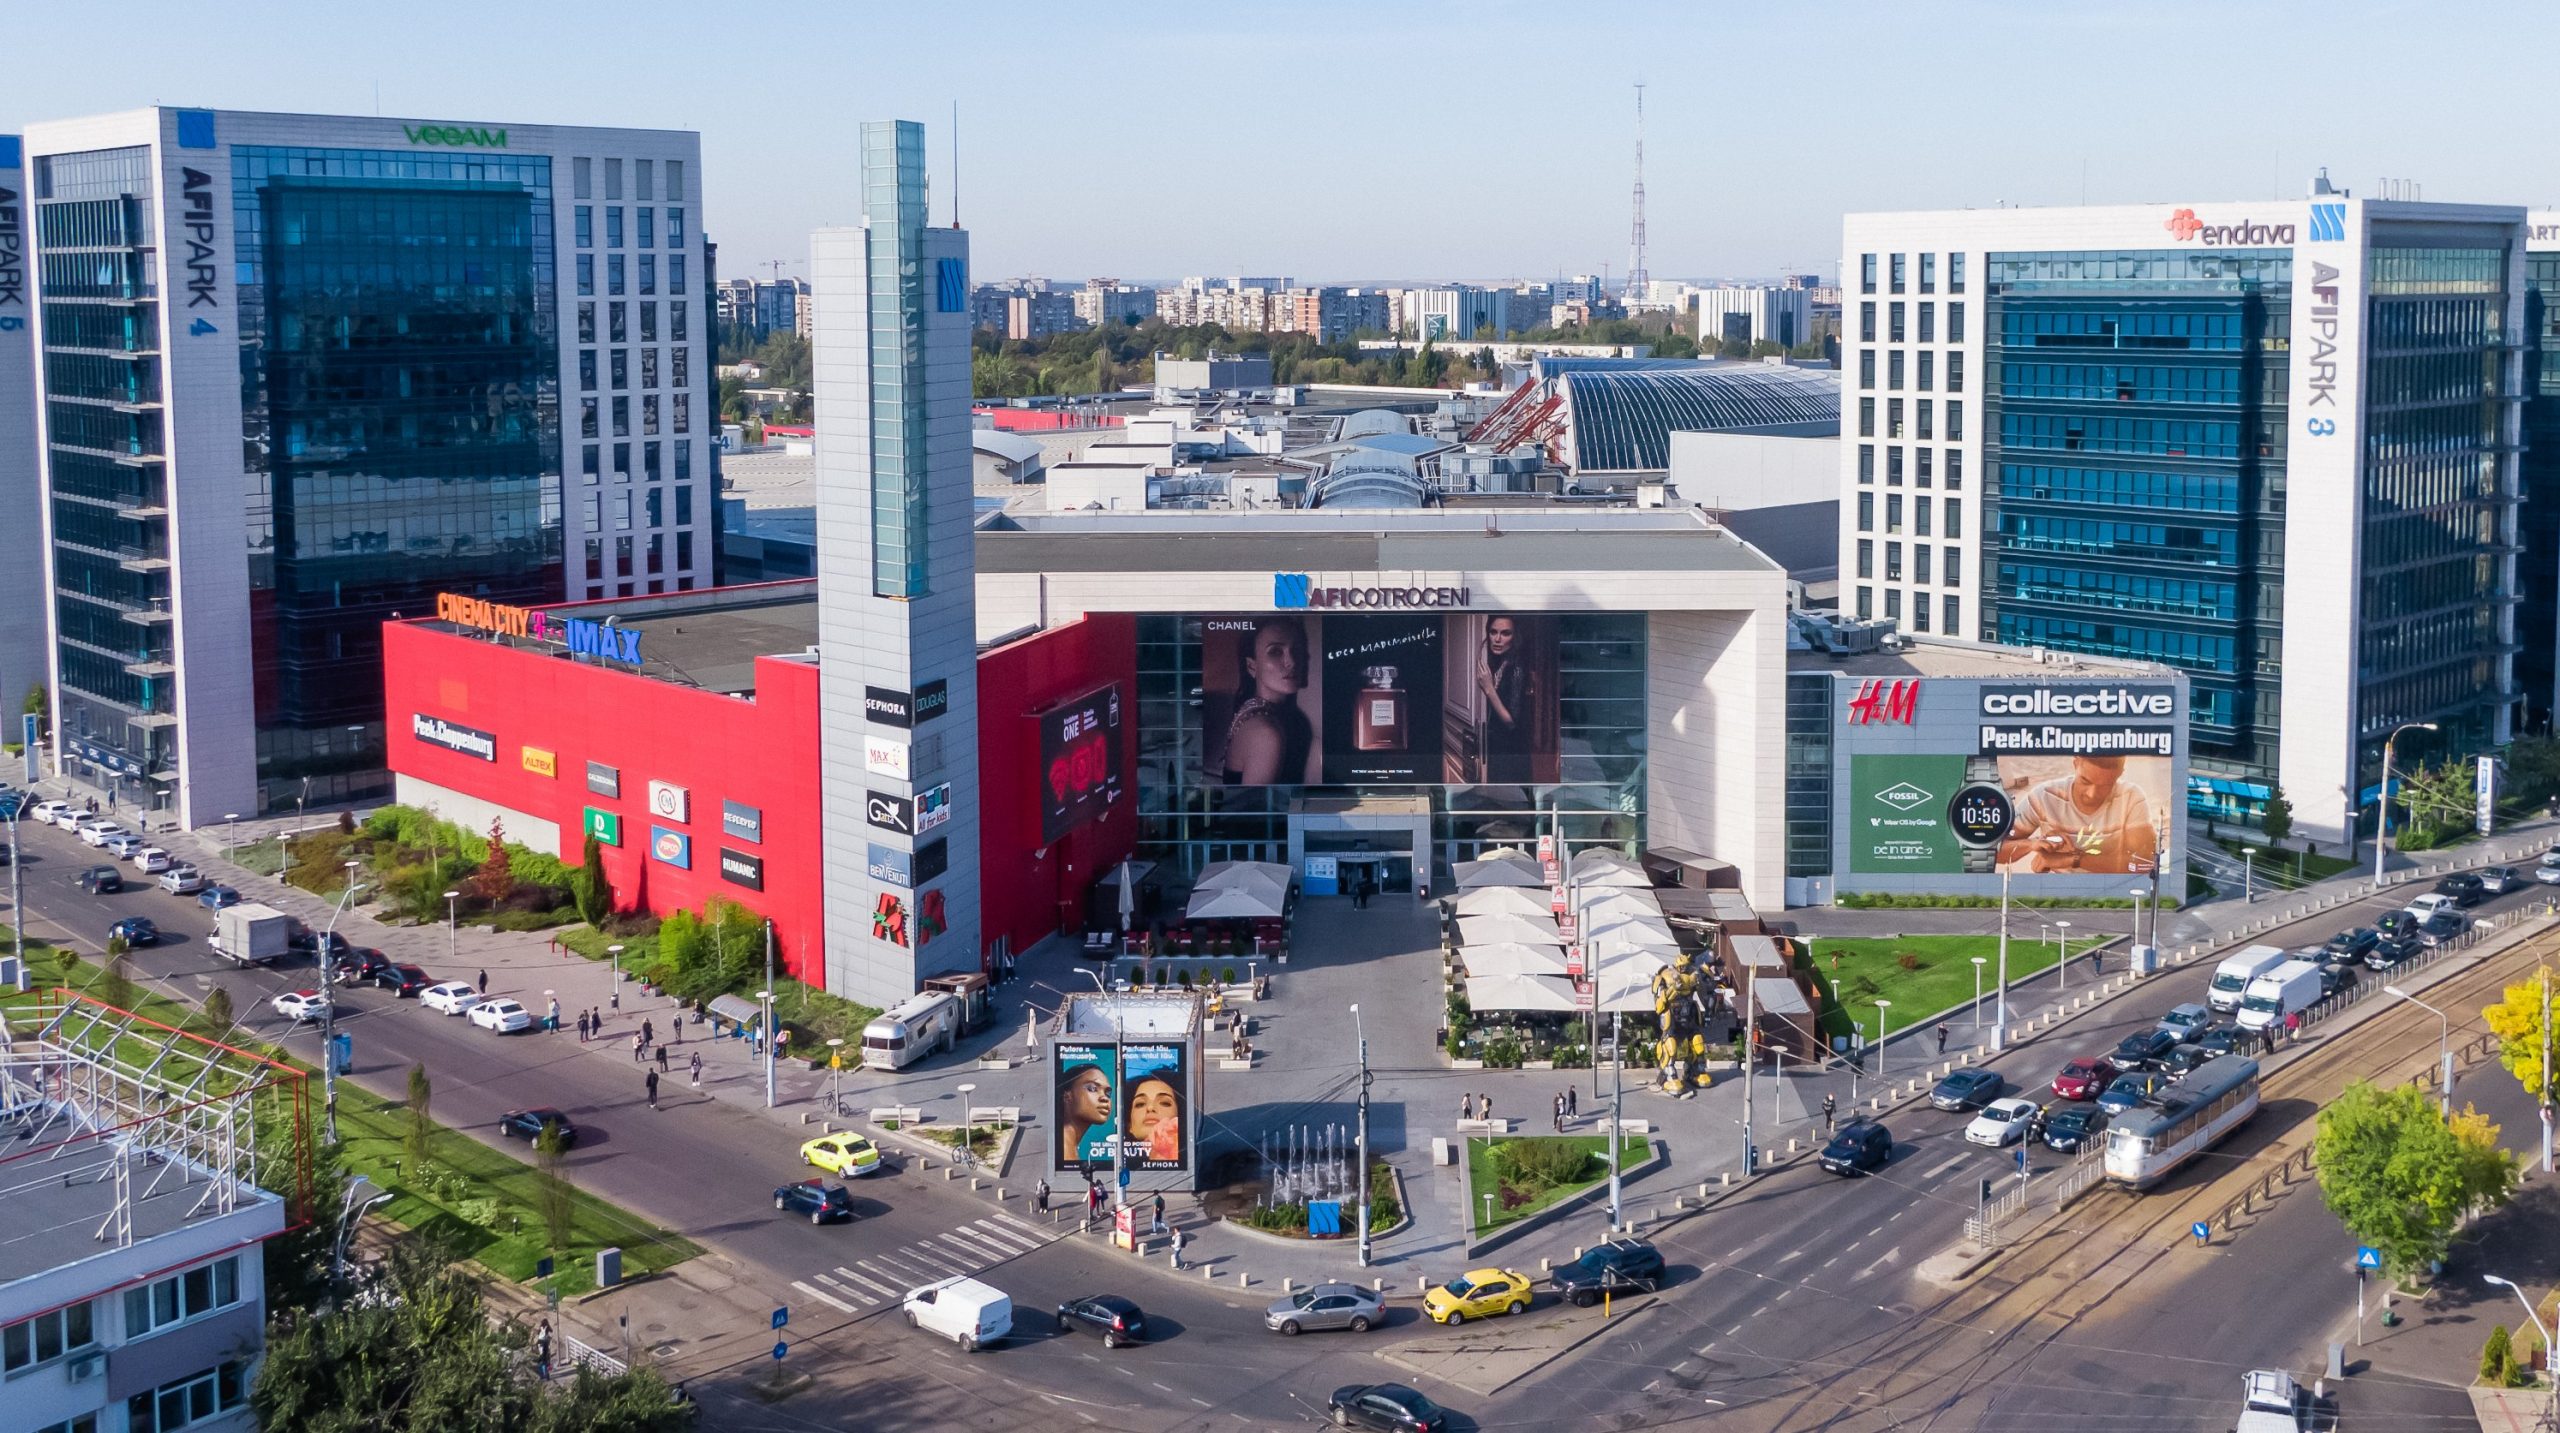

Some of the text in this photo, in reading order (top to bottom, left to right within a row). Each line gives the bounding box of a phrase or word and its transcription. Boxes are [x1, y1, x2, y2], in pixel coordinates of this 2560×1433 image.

[2201, 219, 2295, 246] endava
[181, 165, 219, 337] AFIPARK 4
[2307, 261, 2339, 437] AFIPARK 3
[1308, 587, 1471, 608] AFICOTROCENI
[437, 592, 531, 639] CINEMA CITY
[1207, 621, 1257, 632] CHANEL
[567, 616, 644, 665] IMAX
[866, 698, 906, 716] SEPHORA
[916, 691, 946, 713] DOUGLAS
[1847, 678, 1921, 726] H&M
[1983, 689, 2173, 715] collective
[1063, 720, 1080, 743] ONE
[524, 756, 552, 772] ALTEX
[1889, 792, 1919, 800] FOSSIL
[594, 814, 605, 831] D
[936, 809, 948, 824] kids
[1961, 806, 2001, 825] 10:56
[722, 857, 756, 879] HUMANIC
[870, 863, 909, 886] BENVENUTI
[1090, 1148, 1152, 1157] OF BAUTY
